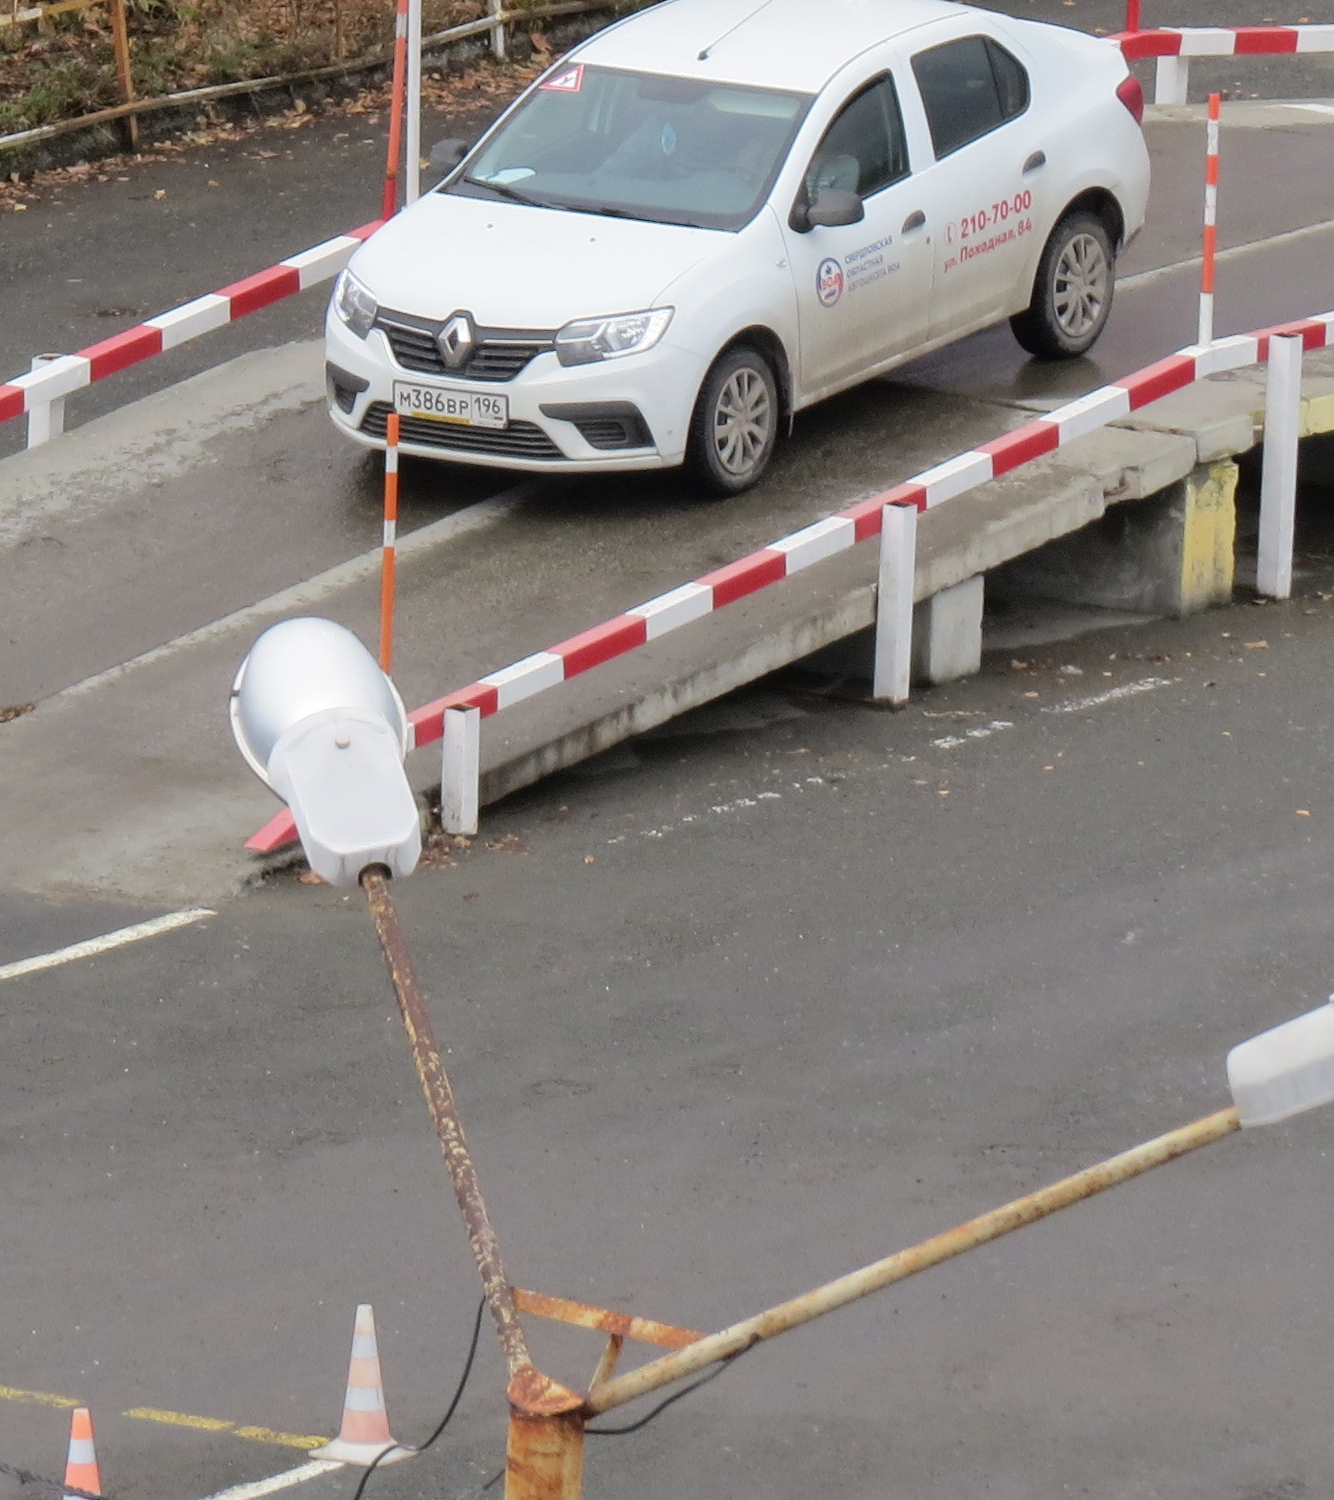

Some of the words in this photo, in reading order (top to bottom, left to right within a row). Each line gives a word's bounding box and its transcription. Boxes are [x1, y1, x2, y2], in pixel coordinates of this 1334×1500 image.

[961, 190, 1031, 239] 210-70-00
[944, 258, 958, 273] ул.
[1018, 217, 1032, 236] 84
[474, 397, 501, 414] 196
